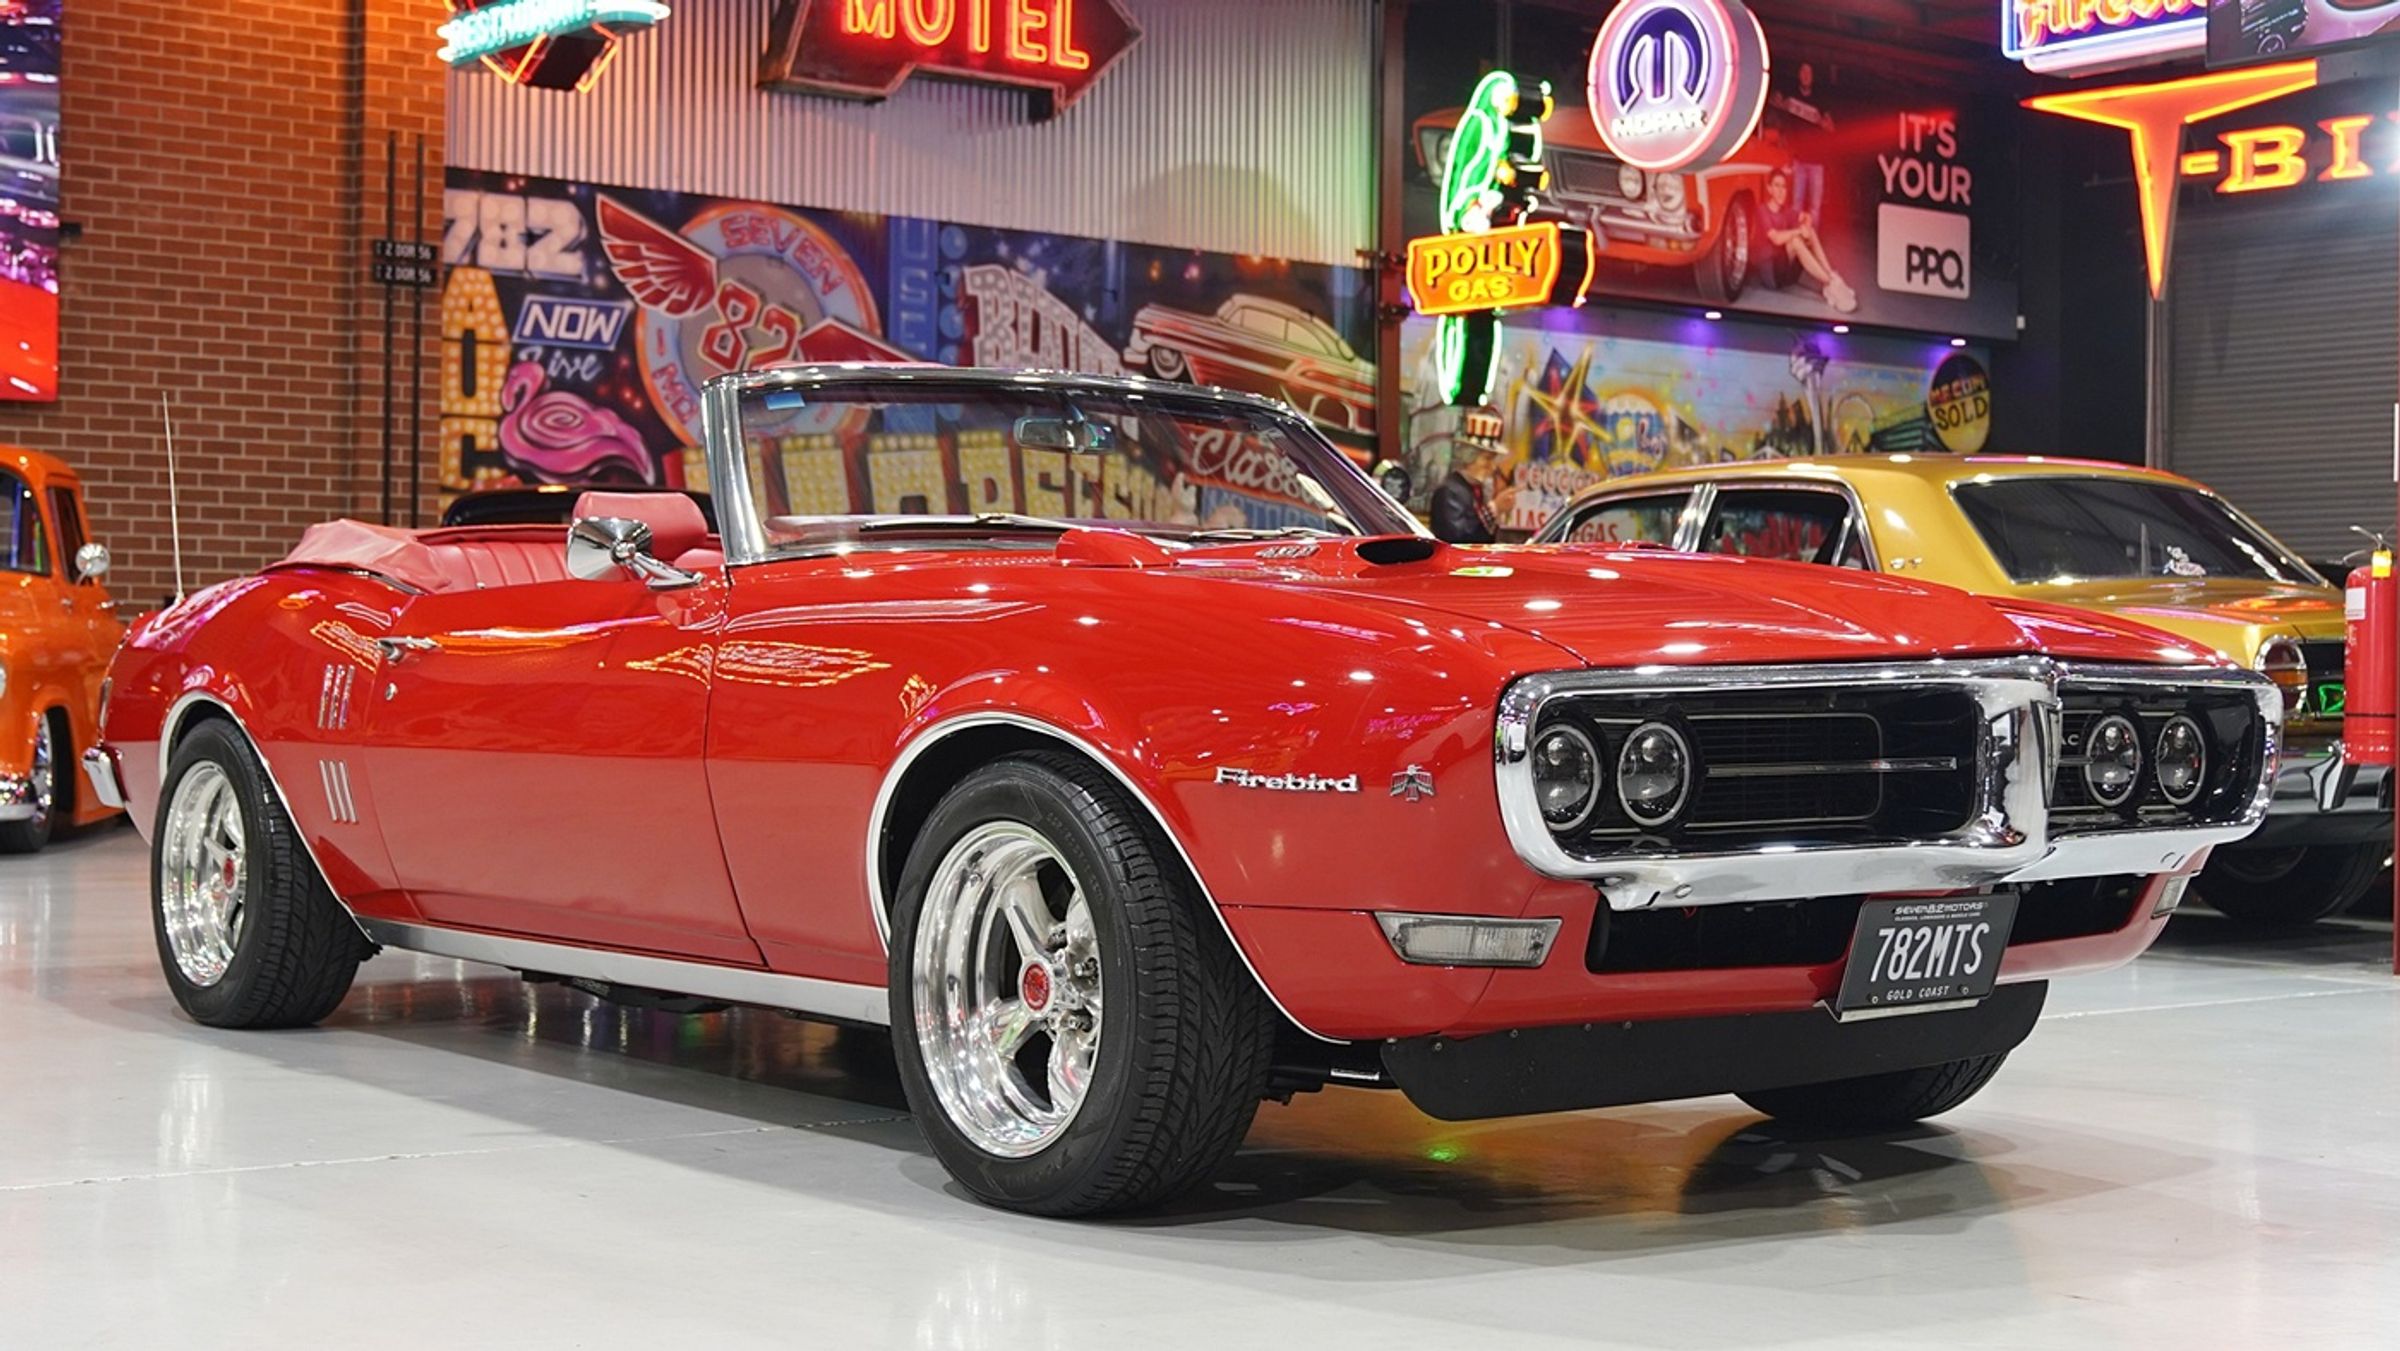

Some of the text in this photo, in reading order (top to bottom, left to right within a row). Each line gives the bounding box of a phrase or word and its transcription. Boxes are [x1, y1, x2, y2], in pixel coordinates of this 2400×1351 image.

[843, 0, 1090, 69] MOTEL
[1611, 109, 1709, 138] MOPAR
[1899, 111, 1957, 158] IT'S
[1877, 153, 1972, 206] YOUR
[443, 188, 591, 284] 782
[720, 214, 845, 296] SEVEN
[1423, 238, 1540, 286] POLLY
[1906, 243, 1965, 290] PPQ
[1448, 275, 1512, 302] GAS
[521, 303, 621, 346] NOW
[1935, 396, 1987, 431] SOLD
[1214, 765, 1359, 792] Firebird
[1870, 922, 1990, 983] 782MTS
[1886, 985, 1950, 1001] GOLD COAST
